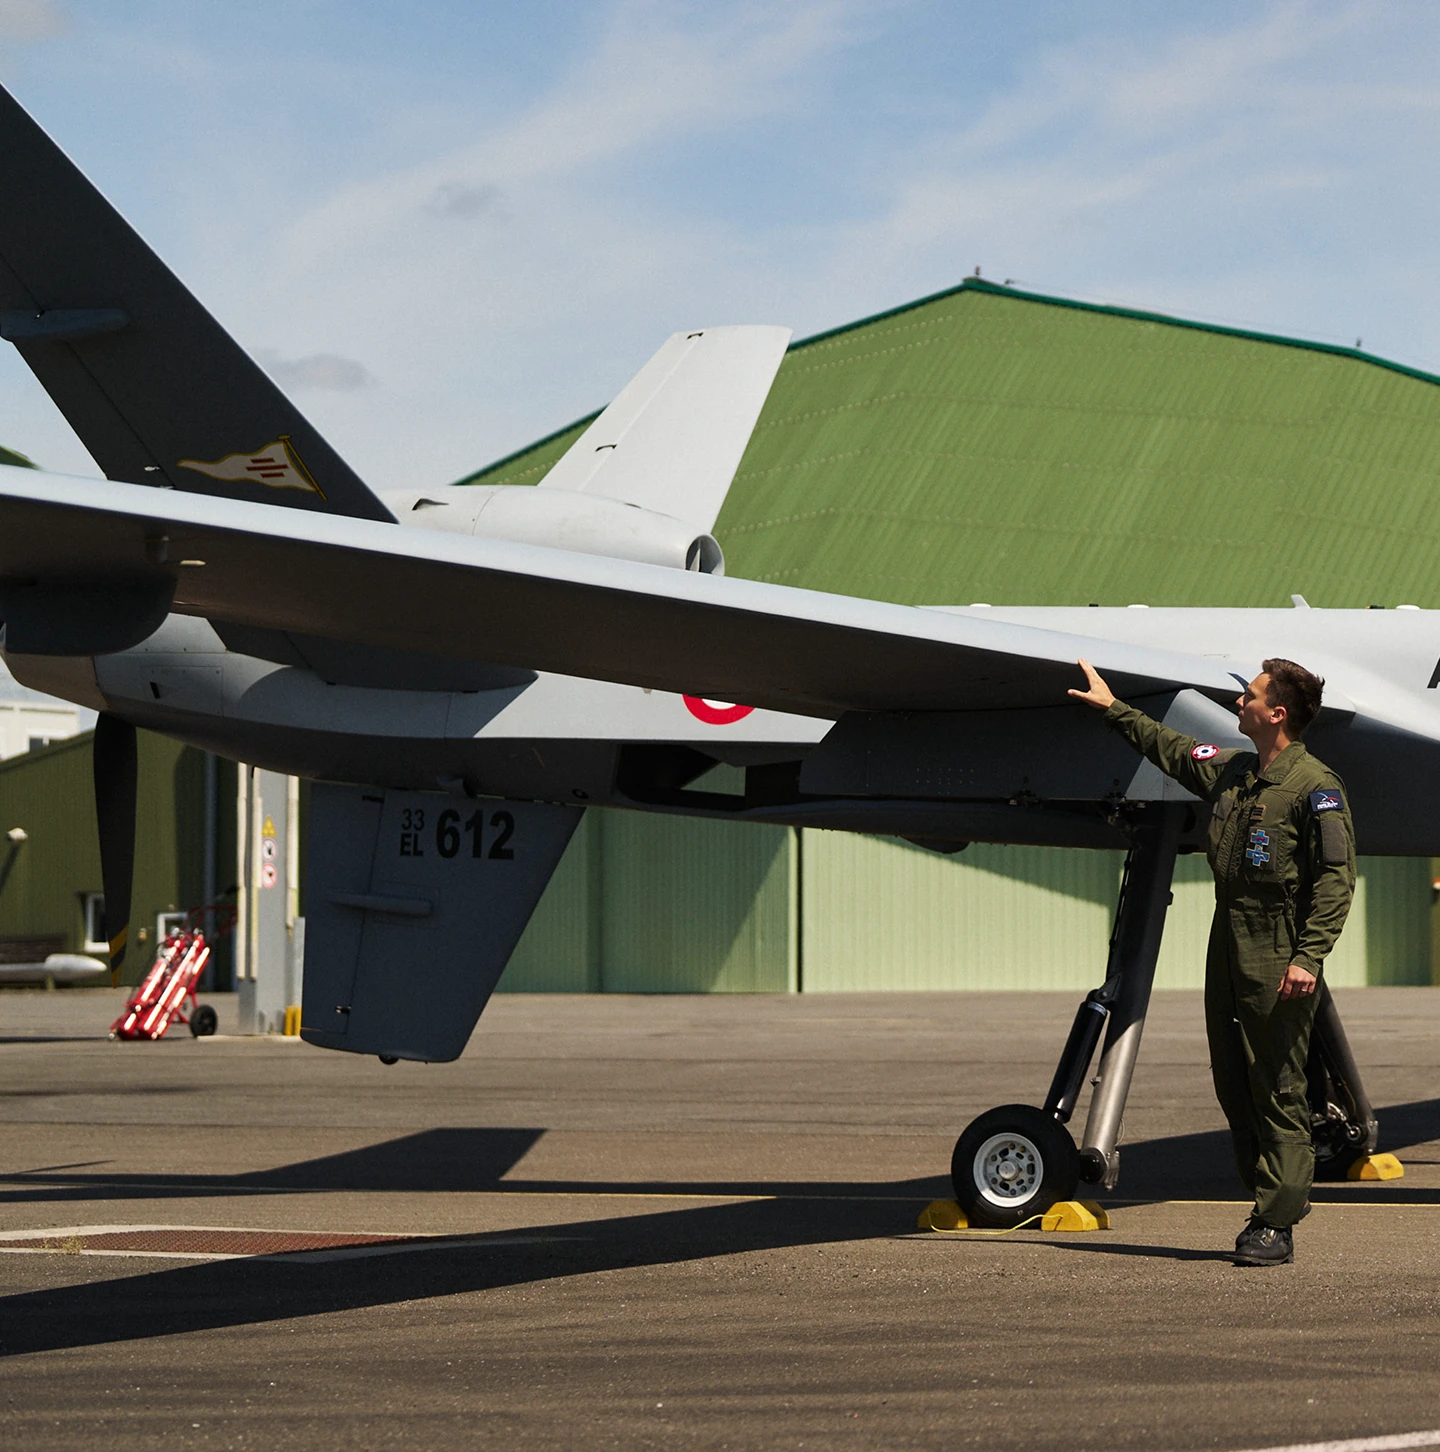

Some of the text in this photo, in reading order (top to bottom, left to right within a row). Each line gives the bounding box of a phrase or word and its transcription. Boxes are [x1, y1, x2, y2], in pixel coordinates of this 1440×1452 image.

[401, 808, 425, 831] 33
[400, 833, 424, 857] EL
[436, 809, 515, 861] 612
